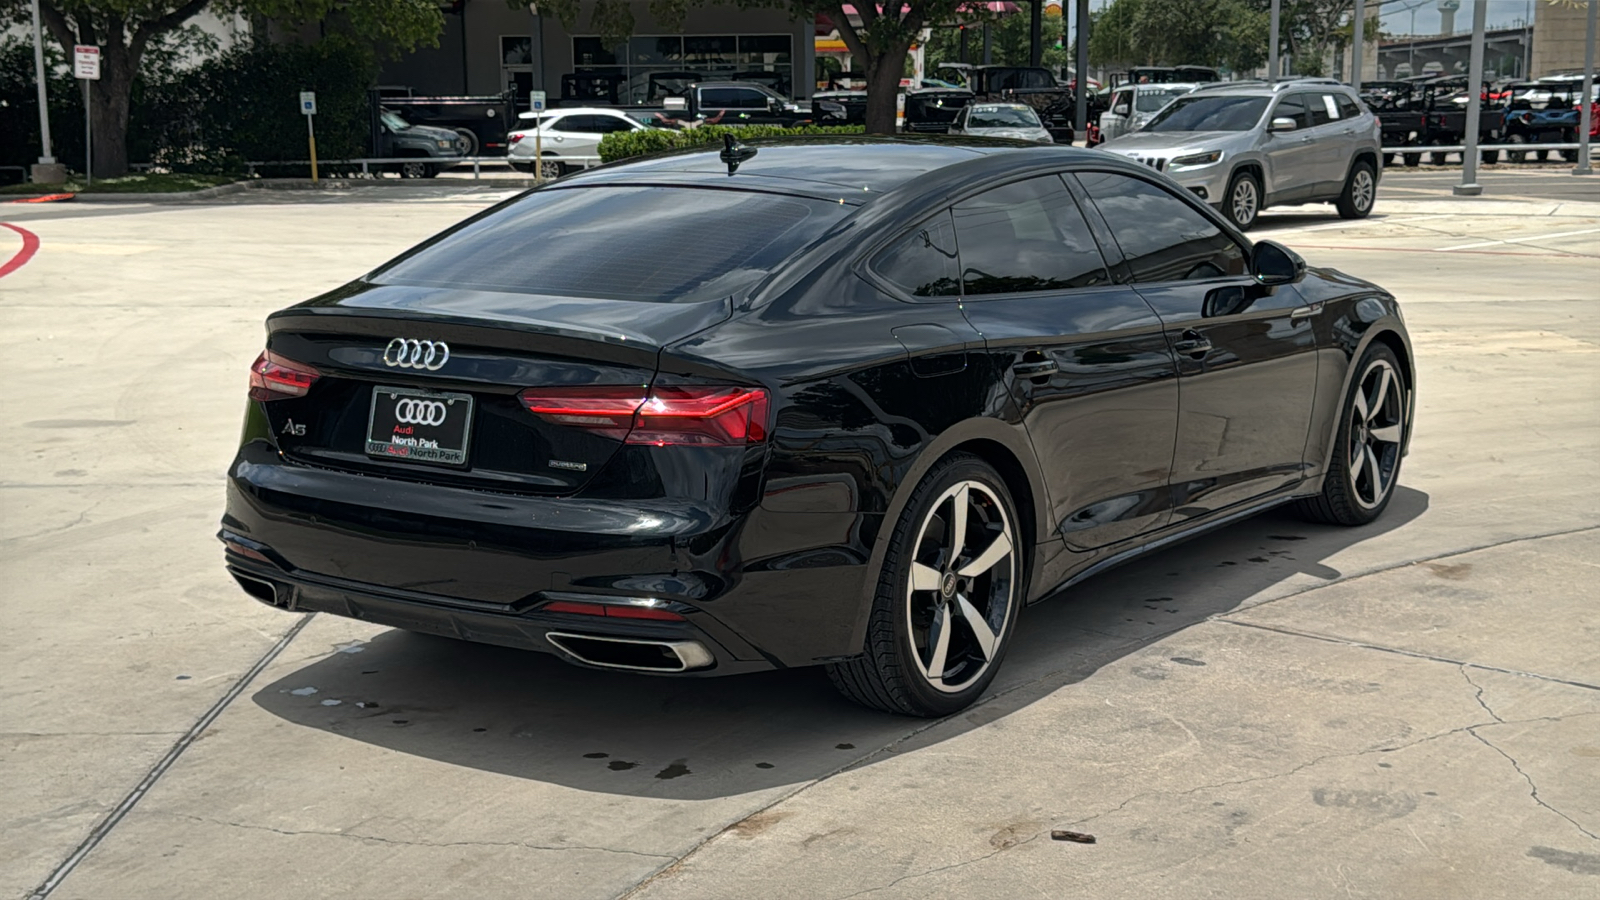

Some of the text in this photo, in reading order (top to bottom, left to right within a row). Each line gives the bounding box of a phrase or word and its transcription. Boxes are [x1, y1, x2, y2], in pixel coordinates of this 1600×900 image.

[281, 417, 306, 436] A5
[393, 425, 413, 435] Audi
[392, 435, 439, 449] North Park
[387, 445, 461, 461] Audi North Park
